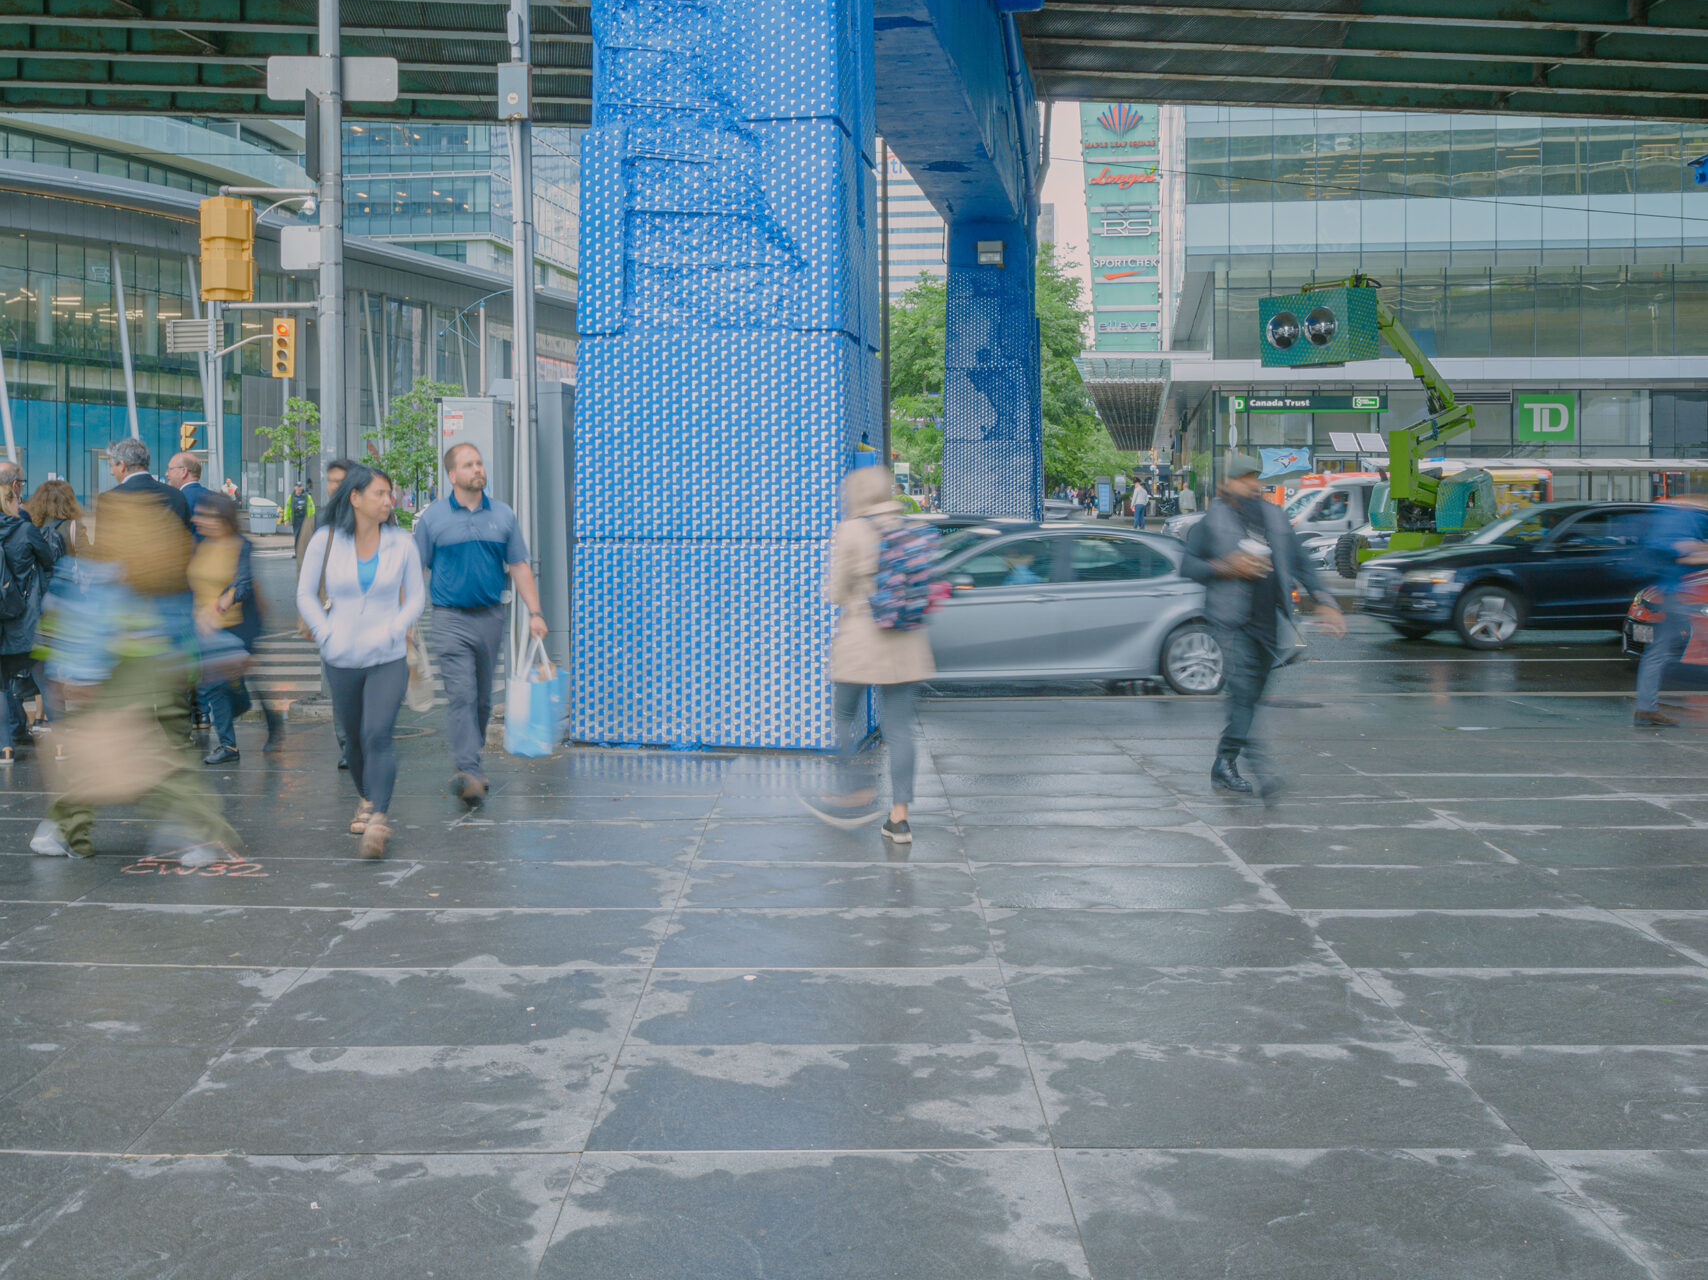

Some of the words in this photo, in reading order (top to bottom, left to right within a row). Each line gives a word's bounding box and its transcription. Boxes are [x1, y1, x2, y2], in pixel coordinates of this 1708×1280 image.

[1110, 140, 1128, 148] LEAF
[1129, 139, 1156, 148] SQUARE
[1100, 219, 1152, 237] RS
[1249, 399, 1283, 407] Canada
[1284, 399, 1310, 407] Trust
[1523, 403, 1569, 432] TD
